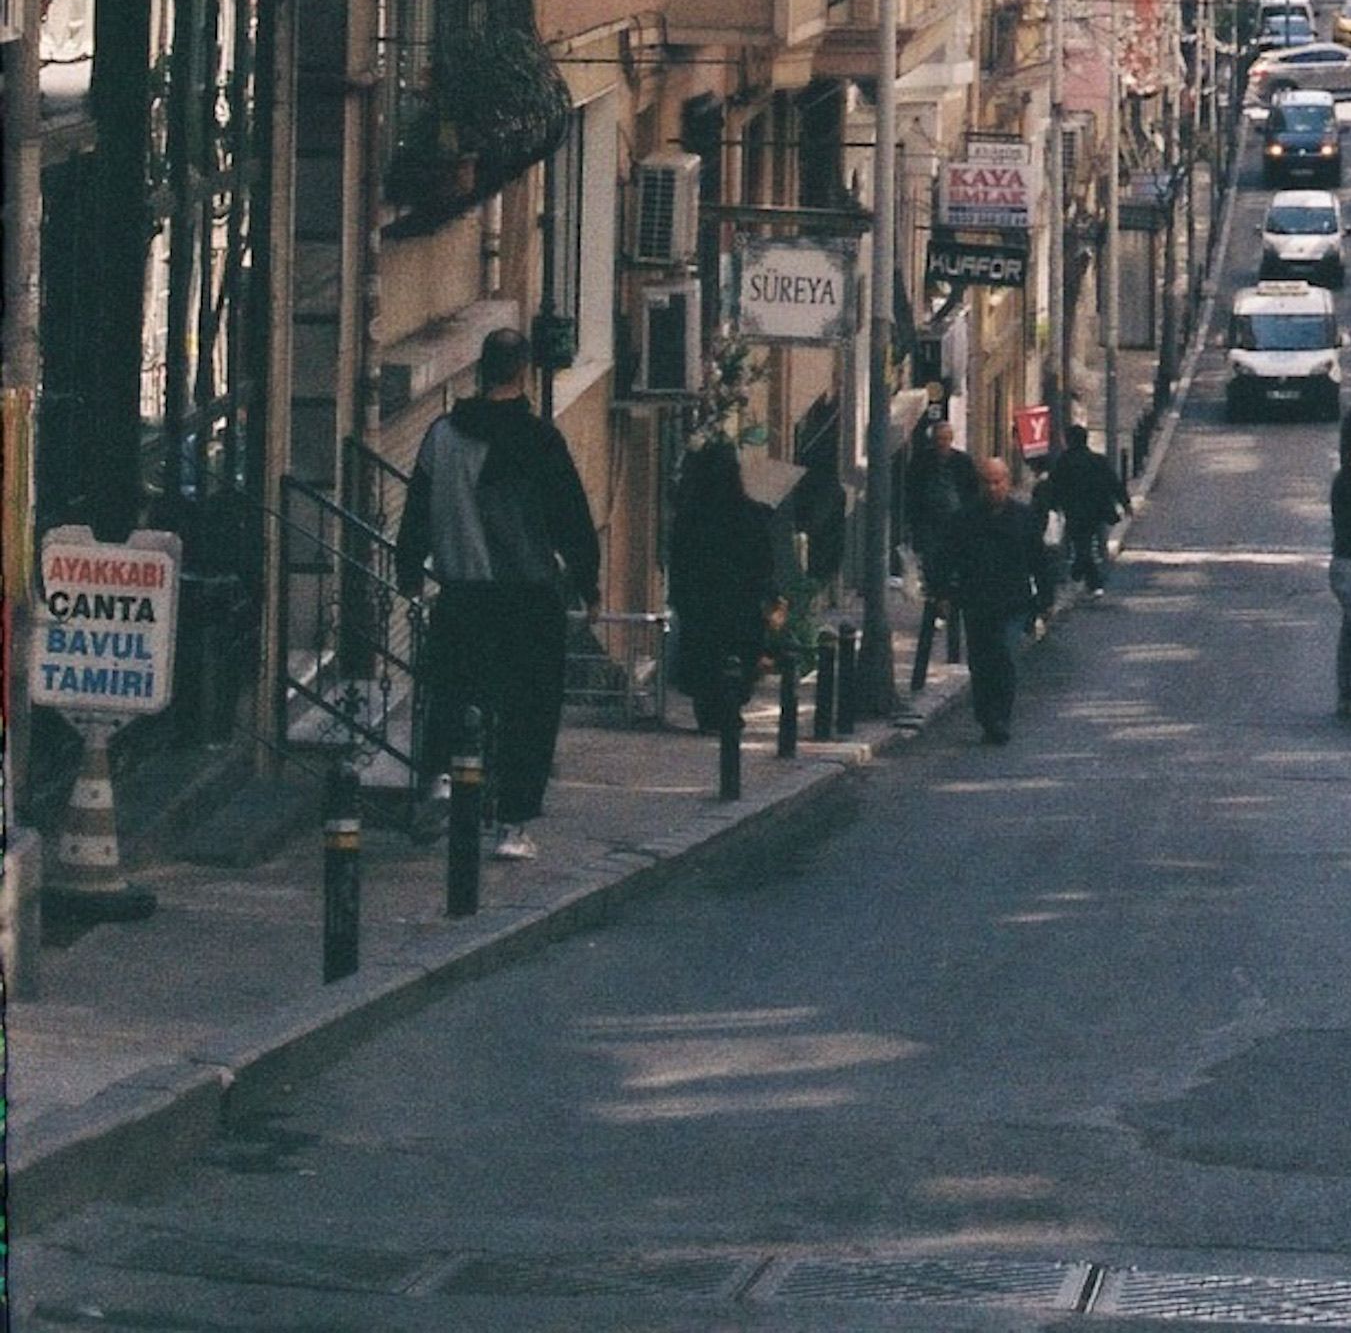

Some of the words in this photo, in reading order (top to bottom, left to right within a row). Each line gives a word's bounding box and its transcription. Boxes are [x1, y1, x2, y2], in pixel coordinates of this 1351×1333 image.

[950, 169, 1024, 187] KAYA
[750, 268, 836, 305] SÜREYA
[49, 556, 165, 590] AYAKKABI
[47, 627, 152, 660] BAVUL
[41, 661, 154, 698] TAMİRİ
